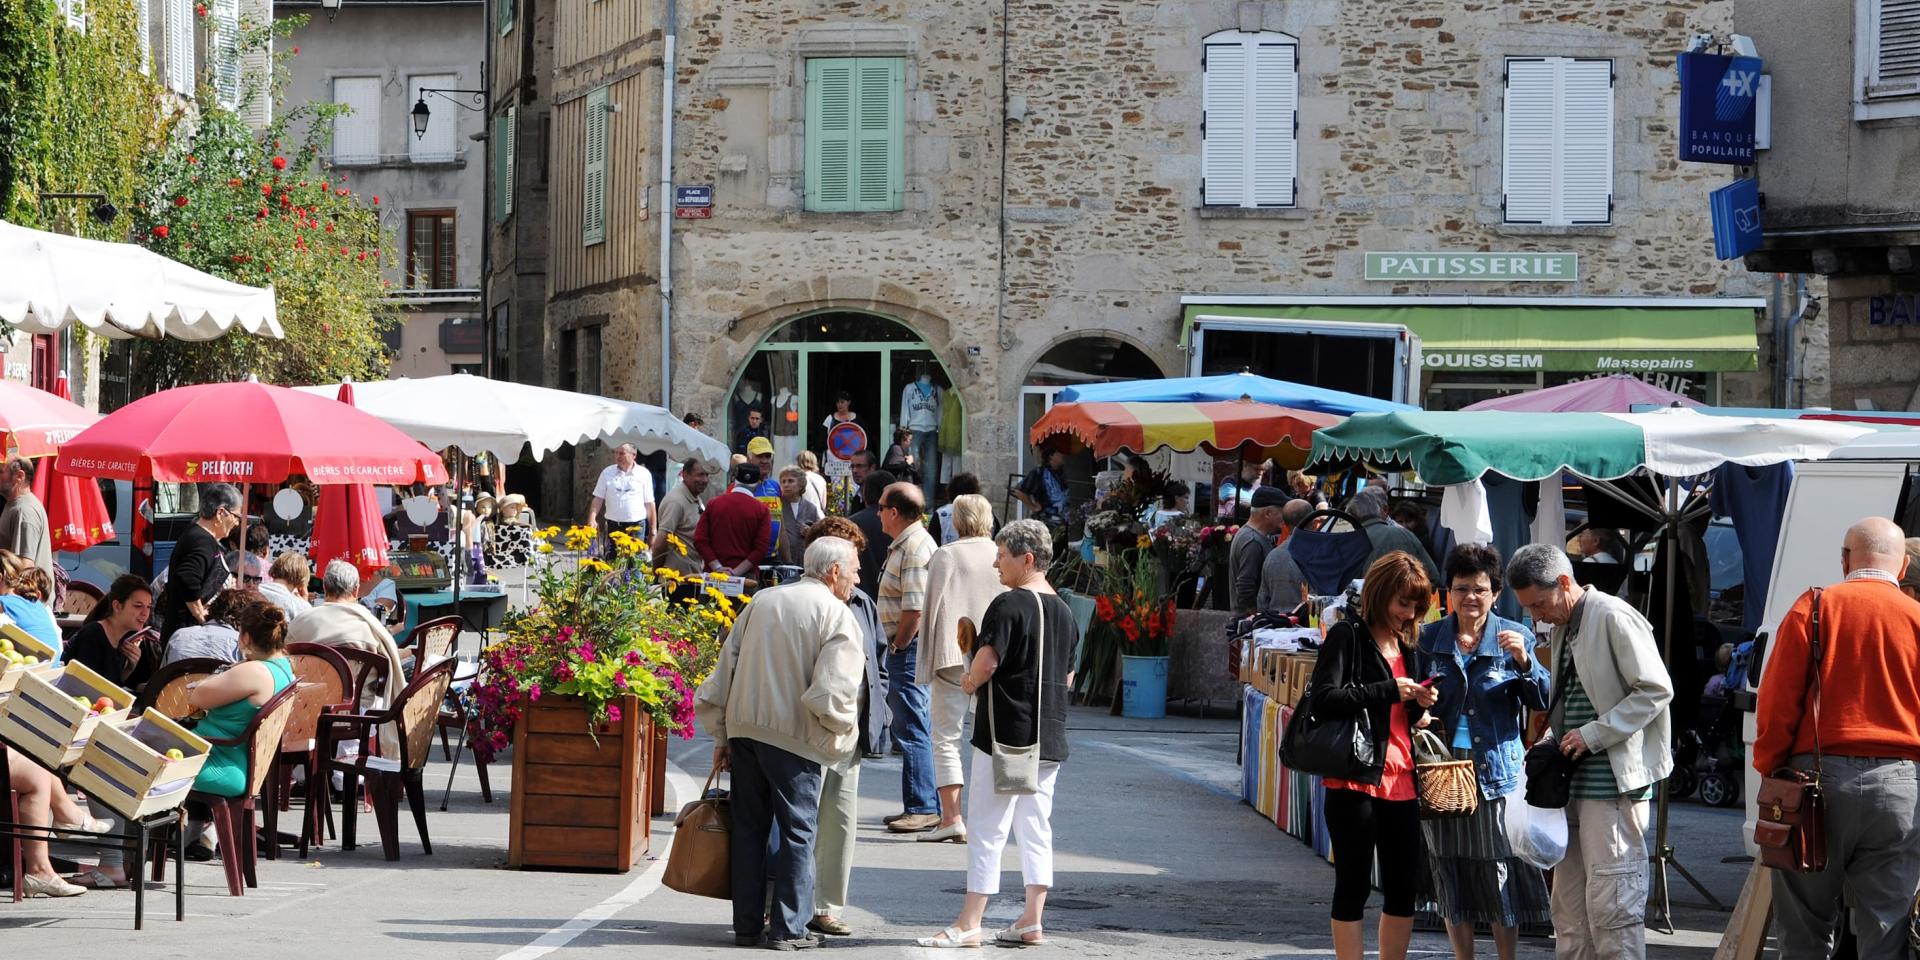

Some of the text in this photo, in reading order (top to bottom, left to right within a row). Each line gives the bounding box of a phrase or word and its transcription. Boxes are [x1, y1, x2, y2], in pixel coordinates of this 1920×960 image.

[1691, 130, 1753, 143] BANQUE
[1691, 145, 1752, 158] POPULAIRE
[1380, 257, 1562, 275] PATISSERIE
[1869, 296, 1920, 325] BA
[1597, 356, 1694, 371] Massepains
[70, 458, 95, 469] BIÈRES
[97, 460, 106, 469] DE
[202, 461, 254, 476] PELFORTH
[313, 464, 405, 476] BIÈRES DE CARACTÈRE
